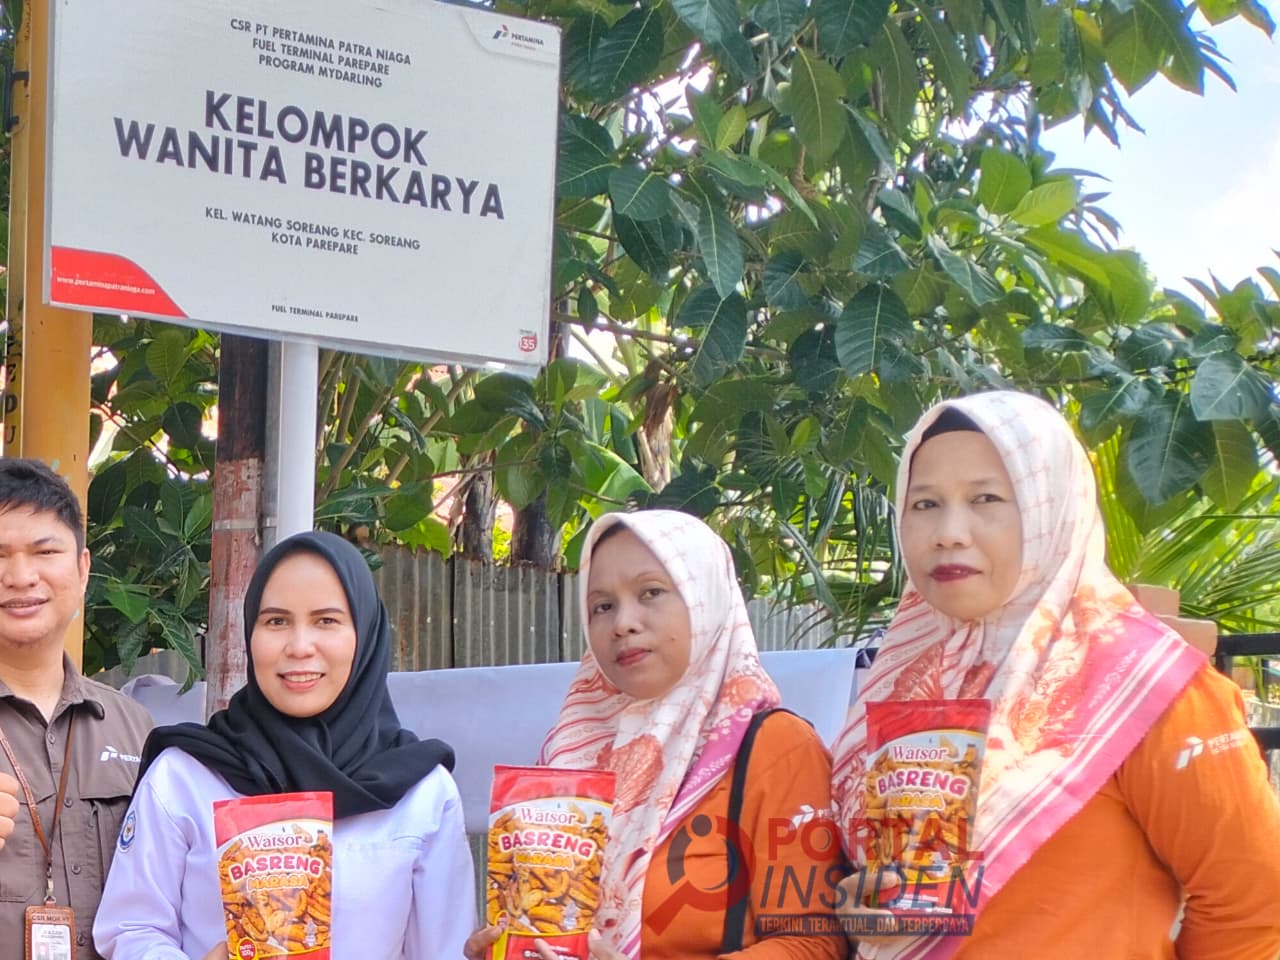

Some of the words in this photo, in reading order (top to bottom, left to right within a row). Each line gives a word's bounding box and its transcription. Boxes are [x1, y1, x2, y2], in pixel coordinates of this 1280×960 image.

[230, 18, 252, 33] CSR
[256, 23, 268, 37] PT
[272, 27, 335, 50] PERTAMINA
[339, 41, 373, 58] PATRA
[376, 49, 411, 66] NIAGA
[252, 38, 276, 53] FUEL
[281, 44, 335, 65] TERMINAL
[338, 56, 390, 76] PAREPARE
[259, 54, 315, 76] PROGRAM
[319, 66, 383, 89] MYDARLING
[204, 89, 429, 167] KELOMPOK
[113, 116, 288, 185] WANITA
[303, 151, 505, 221] BERKARYA
[205, 206, 228, 221] KEL.
[232, 210, 283, 229] WATANG
[286, 219, 340, 238] SOREANG
[343, 228, 366, 243] KEC.
[369, 233, 421, 251] SOREANG
[271, 231, 302, 247] KOTA
[306, 238, 359, 255] PAREPARE
[271, 304, 287, 314] FUEL
[289, 306, 324, 319] TERMINAL
[325, 311, 359, 323] PAREPARE
[893, 745, 948, 760] Watsor
[877, 770, 968, 796] BASRENG
[521, 807, 577, 825] Watsor
[247, 835, 303, 849] Watsor
[500, 831, 593, 858] BASRENG
[230, 855, 321, 881] BASRENG
